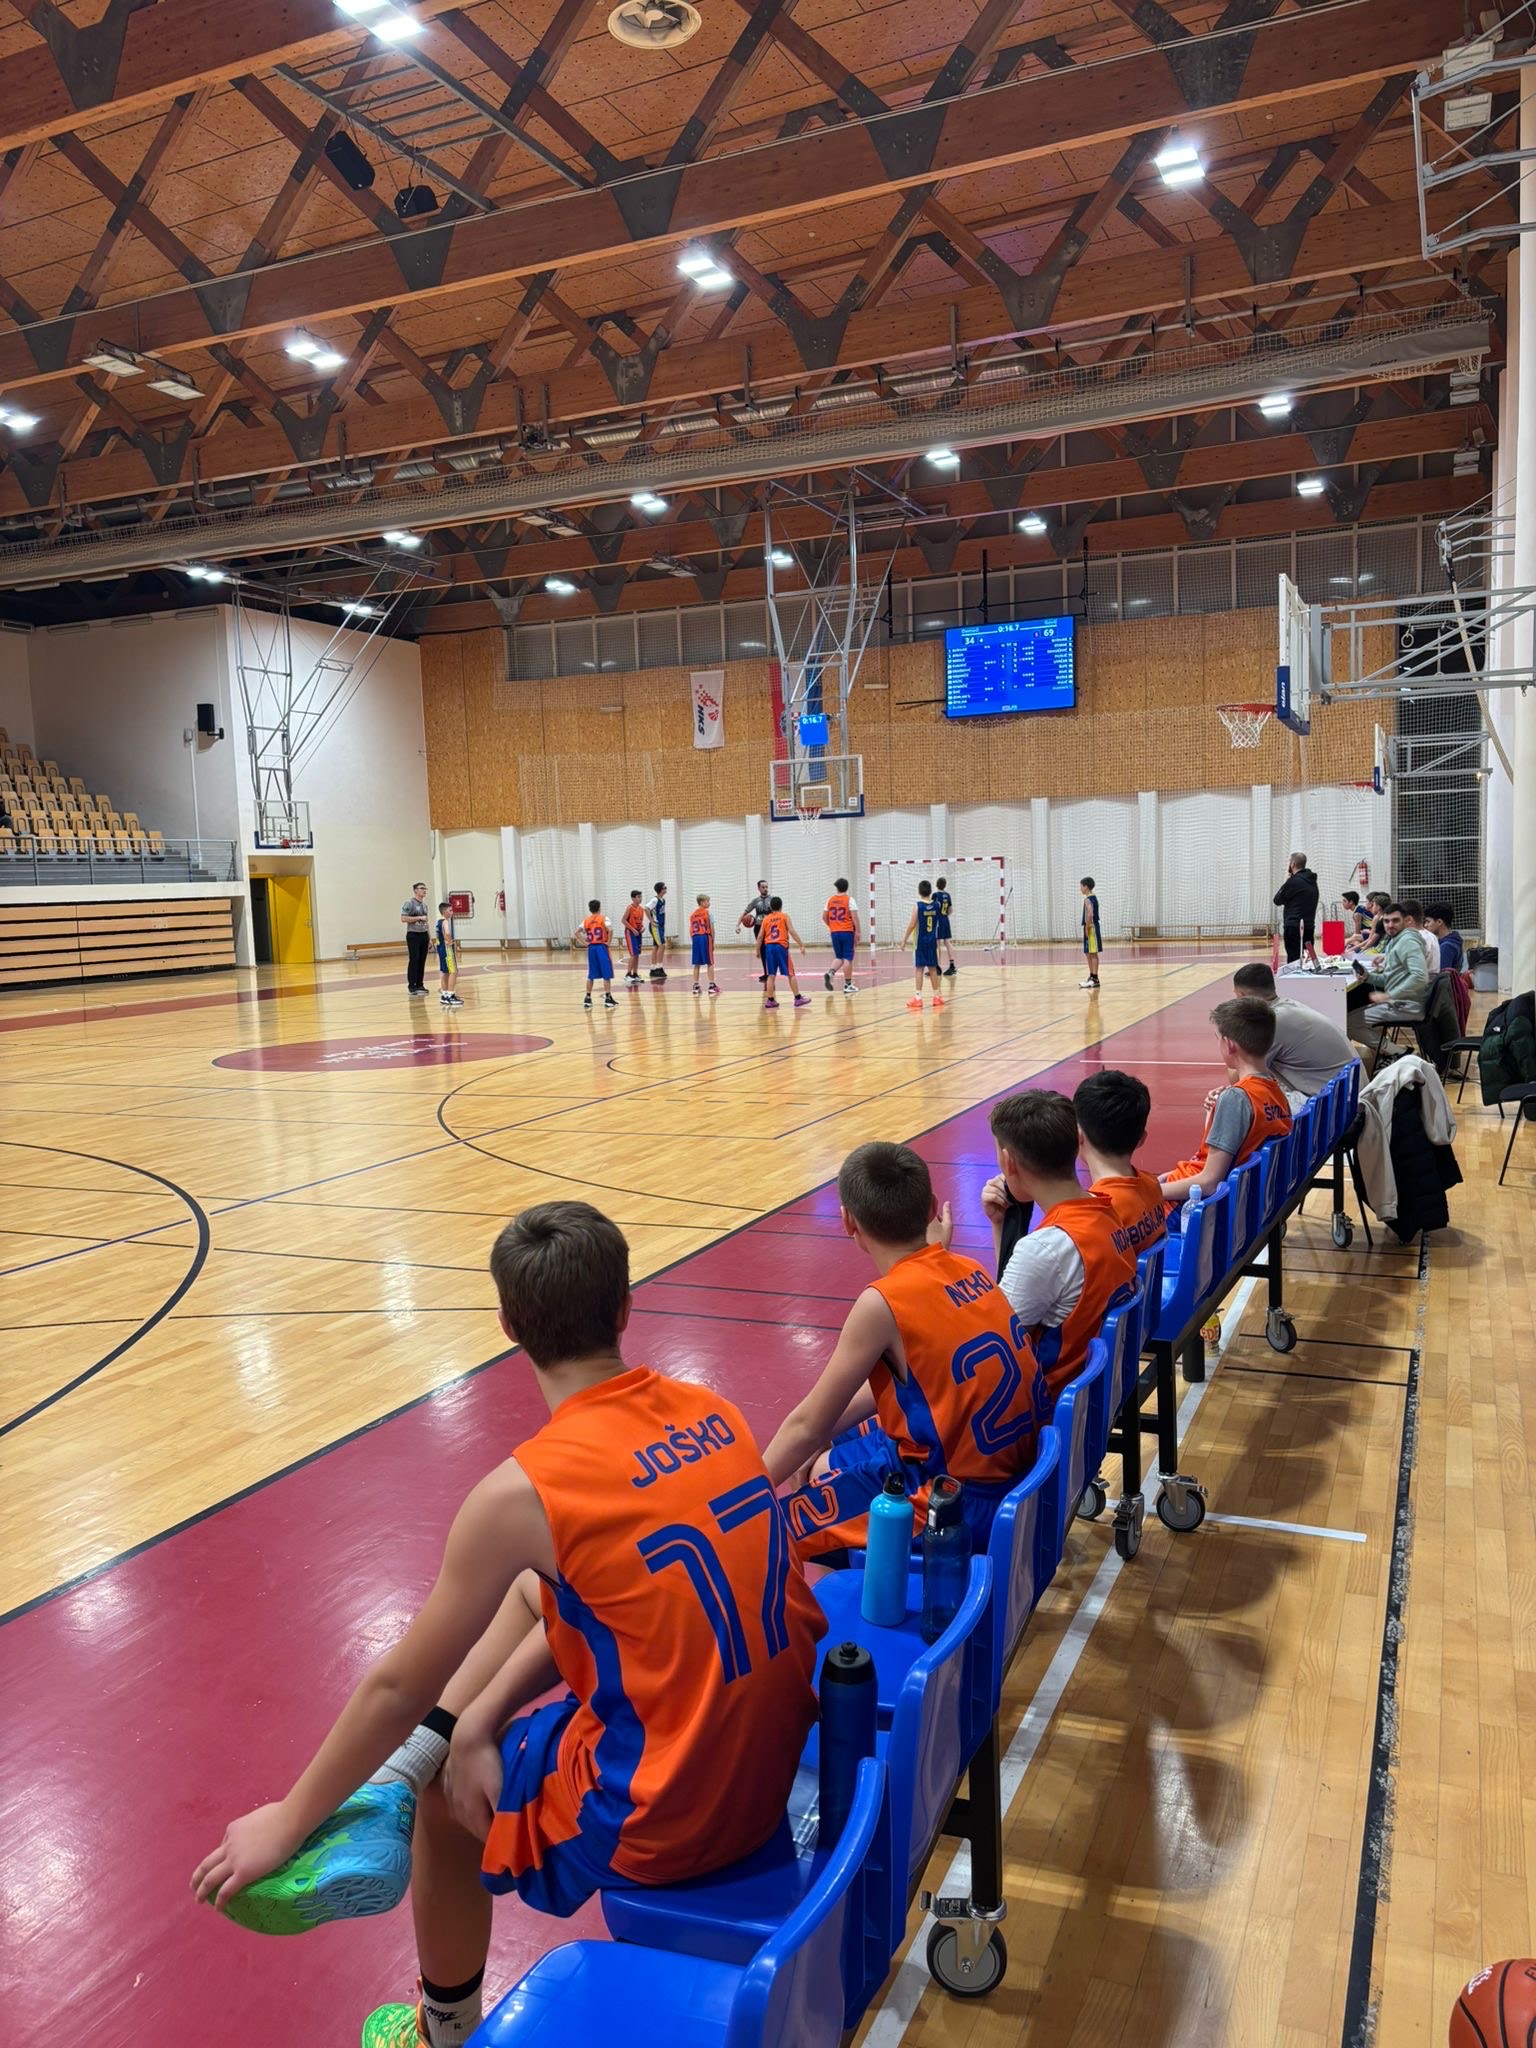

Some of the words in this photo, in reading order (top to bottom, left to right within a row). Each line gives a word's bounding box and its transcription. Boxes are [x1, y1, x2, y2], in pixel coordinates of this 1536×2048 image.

[998, 624, 1020, 633] 0:16.7
[1043, 627, 1054, 637] 69
[964, 636, 975, 645] 34
[802, 716, 823, 725] 0:16.7
[829, 906, 846, 921] 32
[926, 916, 933, 933] 9
[631, 1413, 736, 1489] JOŠKO
[636, 1474, 791, 1686] 17
[427, 2006, 457, 2020] NIKE
